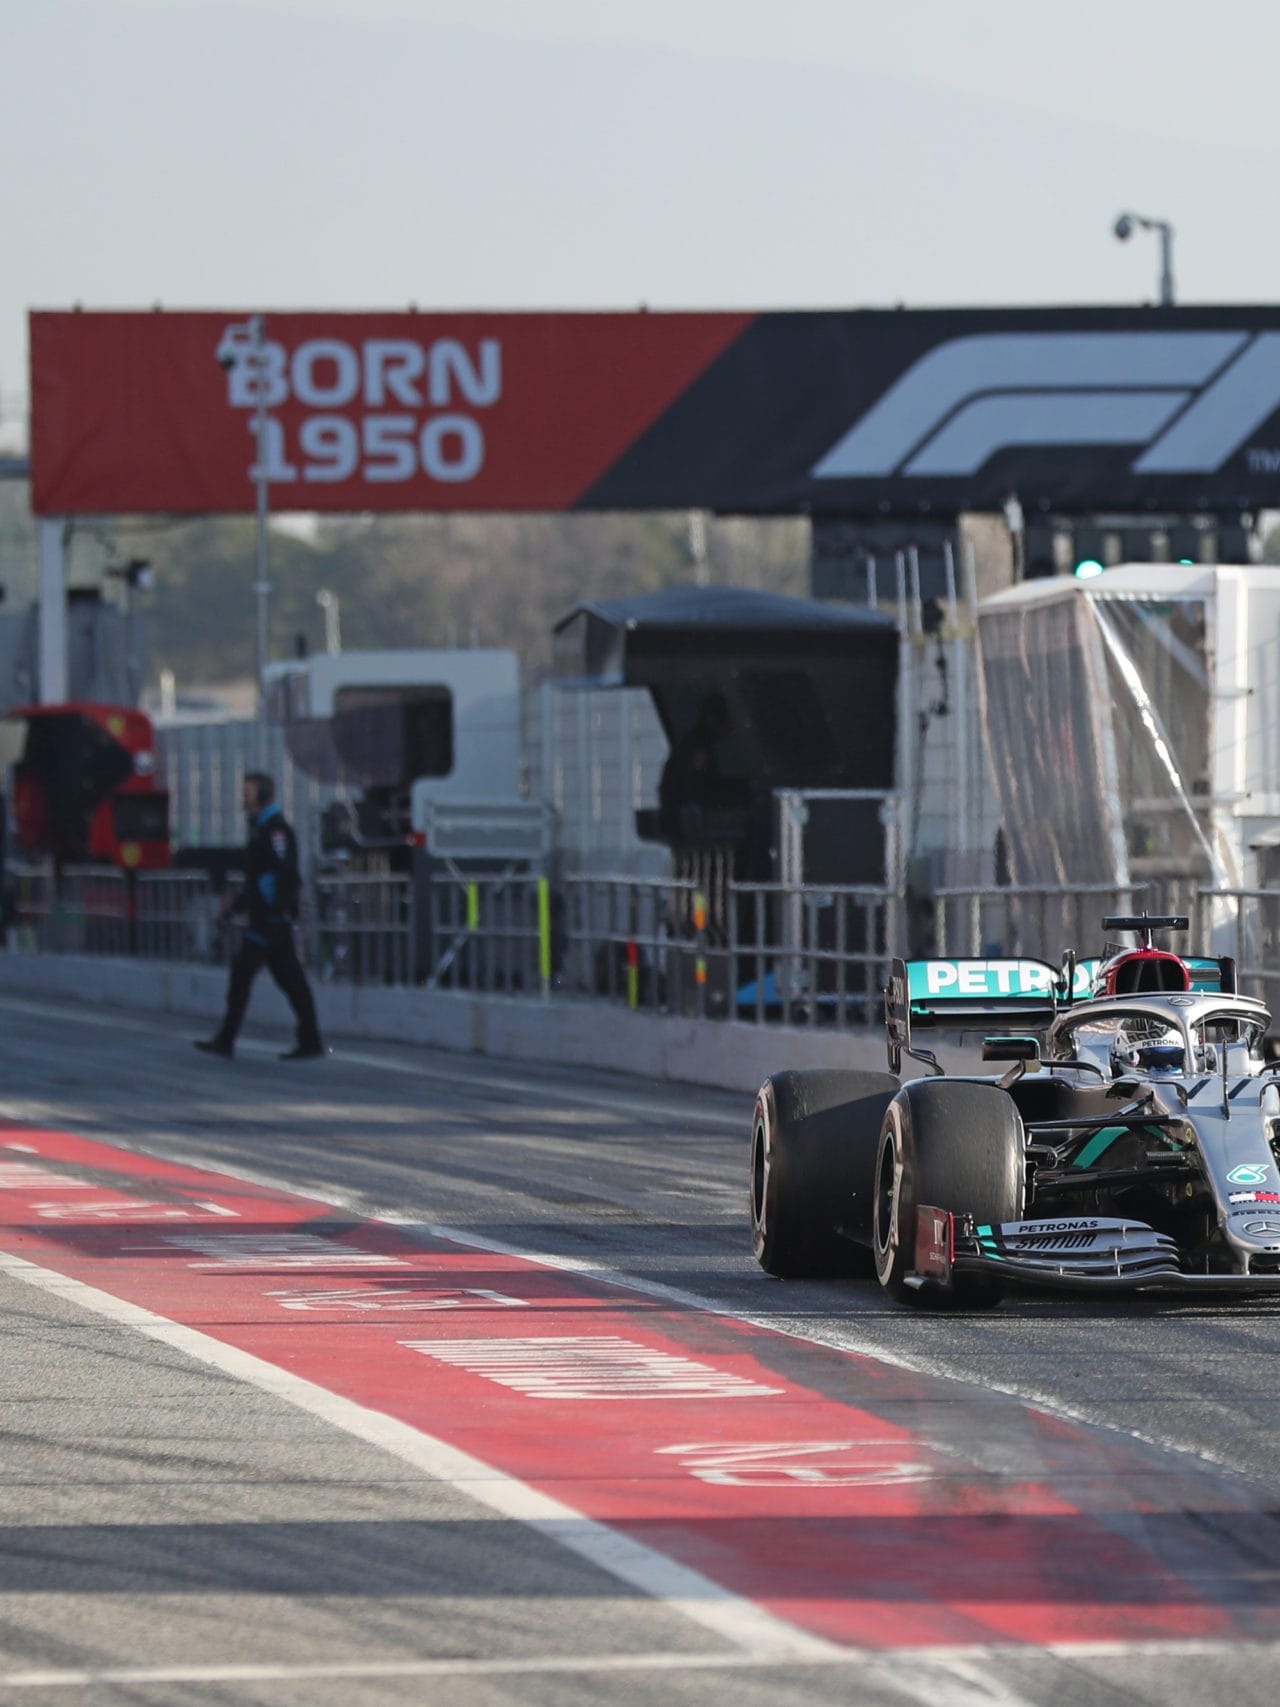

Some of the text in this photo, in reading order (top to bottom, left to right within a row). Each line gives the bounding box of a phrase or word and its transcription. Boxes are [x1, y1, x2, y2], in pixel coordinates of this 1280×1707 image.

[228, 337, 502, 407] BORN
[249, 414, 486, 482] 1950
[1018, 1220, 1099, 1234] PETRONAS
